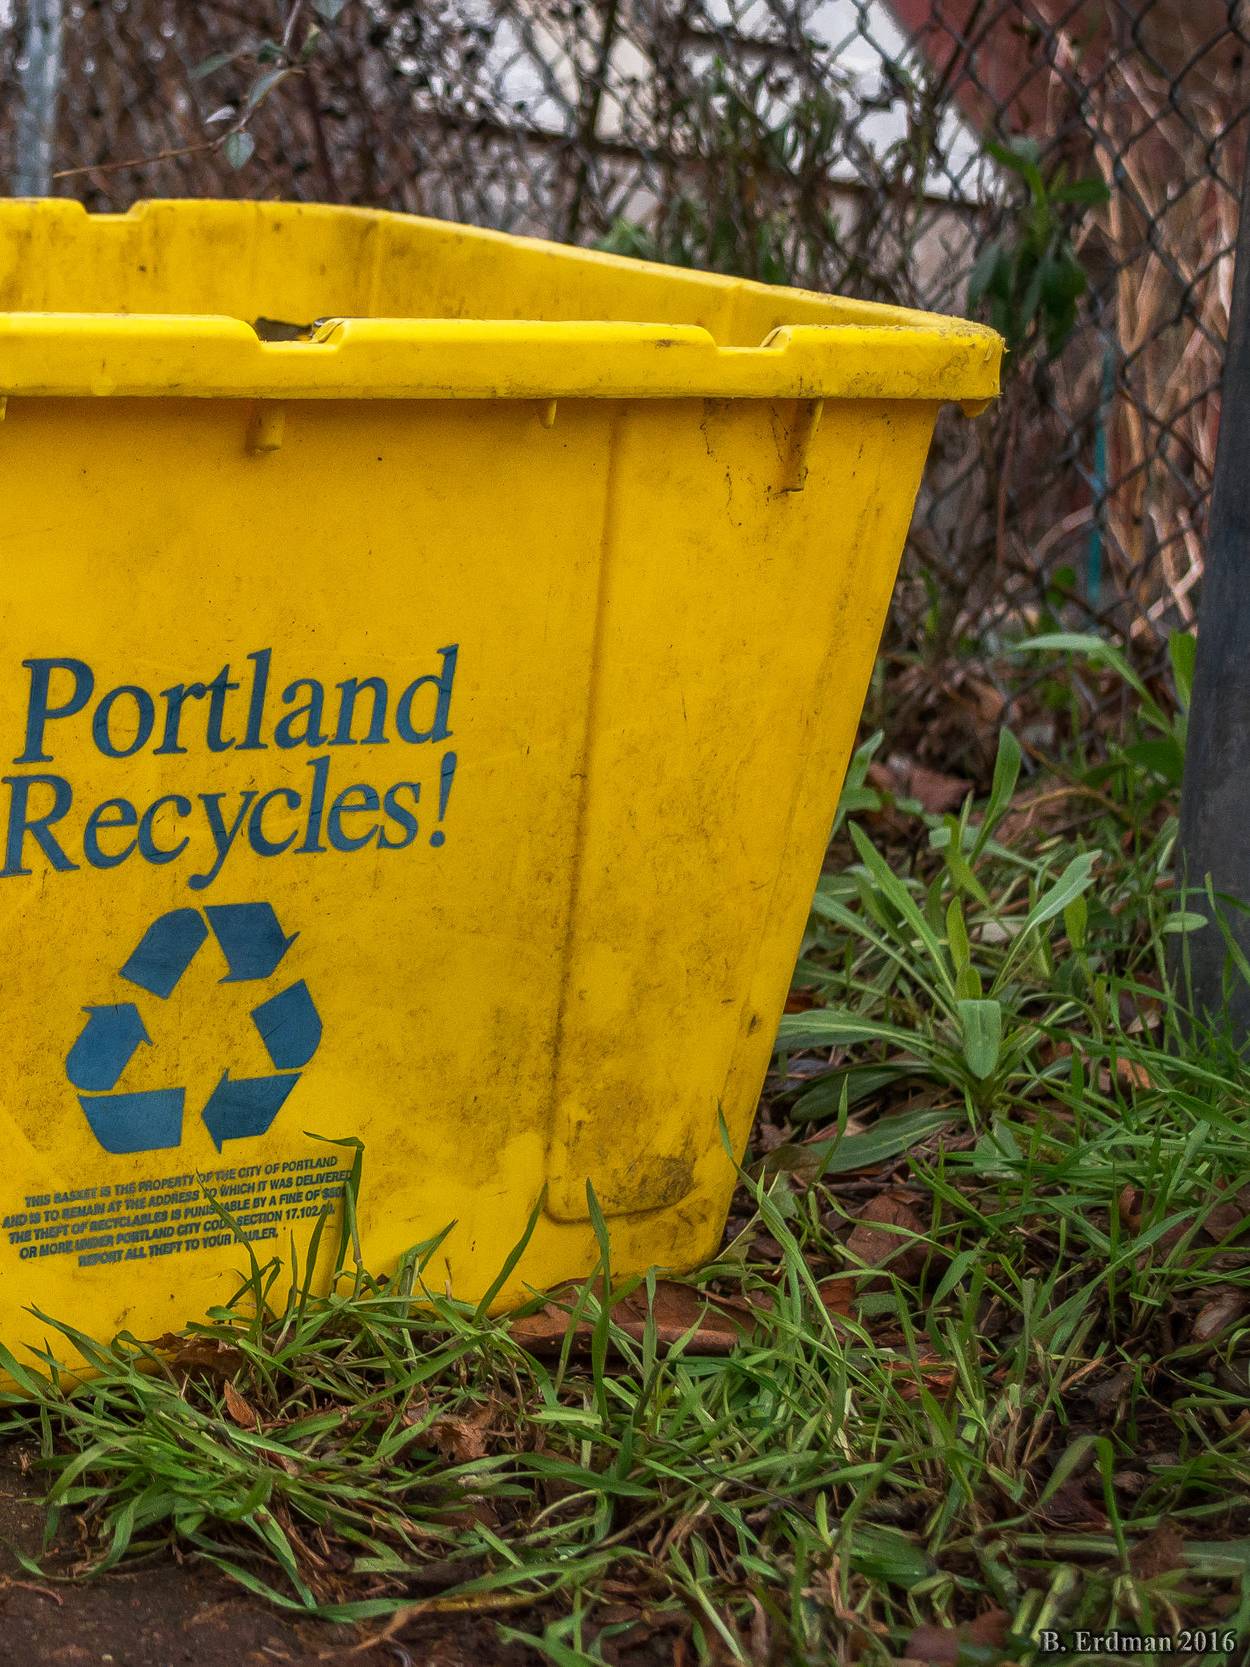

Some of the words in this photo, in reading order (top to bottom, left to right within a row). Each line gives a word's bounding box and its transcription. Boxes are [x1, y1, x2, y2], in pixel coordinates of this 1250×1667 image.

[12, 643, 459, 765] Portland
[2, 1213, 27, 1229] AND
[29, 1212, 41, 1224] IS
[43, 1210, 60, 1222] TO
[62, 1202, 106, 1219] REMAIN
[107, 1200, 122, 1213] AT
[124, 1197, 146, 1210] THE
[148, 1190, 200, 1207] ADDRESS
[203, 1187, 217, 1199] TO
[220, 1182, 256, 1197] WHICH
[257, 1180, 268, 1192] IT
[270, 1177, 293, 1190] WAS
[295, 1170, 352, 1187] DELIVERED
[25, 1194, 51, 1208] THIS
[53, 1187, 98, 1204] BASKET
[100, 1186, 111, 1198] IS
[114, 1182, 136, 1196] THE
[138, 1174, 195, 1192] PROPERTY
[198, 1171, 213, 1183] OF
[215, 1168, 236, 1182] THE
[237, 1165, 262, 1179] CITY
[264, 1162, 279, 1175] OF
[282, 1156, 338, 1173] PORTLAND
[8, 1229, 32, 1245] THE
[34, 1224, 70, 1241] THEFT
[71, 1221, 88, 1235] OF
[89, 1210, 168, 1232] RECYCLABLES
[170, 1208, 182, 1221] IS
[184, 1198, 250, 1220] PUNISABLE
[252, 1196, 267, 1209] BY
[269, 1195, 277, 1206] A
[279, 1191, 303, 1206] FINE
[305, 1189, 320, 1201] OF
[19, 1246, 37, 1260] OR
[39, 1240, 73, 1256] MORE
[75, 1234, 114, 1251] UNDER
[116, 1226, 174, 1245] PORTLAND
[177, 1222, 201, 1236] CITY
[203, 1216, 233, 1232] COD
[236, 1211, 282, 1226] SECTION
[78, 1249, 124, 1267] REPORT
[124, 1247, 147, 1260] ALL
[148, 1240, 183, 1257] THEFT
[185, 1238, 200, 1251] TO
[202, 1234, 231, 1249] YOUR
